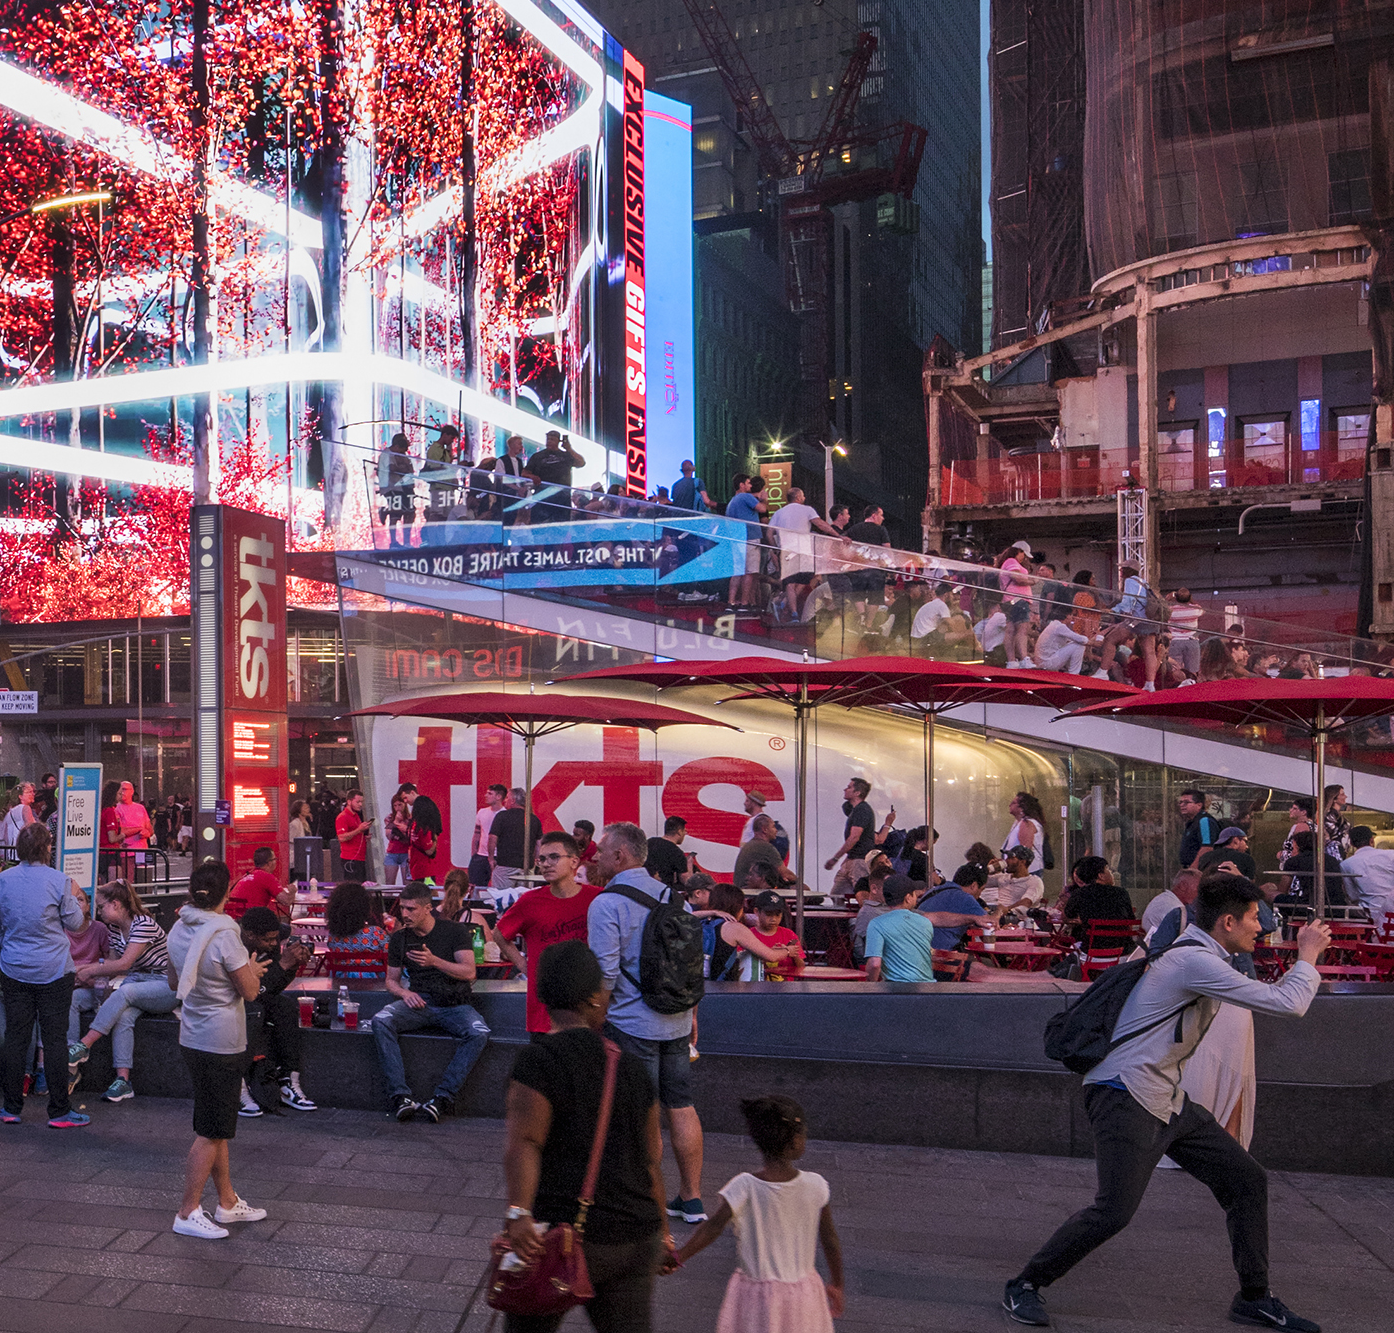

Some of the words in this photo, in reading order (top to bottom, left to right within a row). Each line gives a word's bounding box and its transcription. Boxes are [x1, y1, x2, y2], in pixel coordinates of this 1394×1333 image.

[625, 66, 645, 278] EXCLUSIVE
[626, 279, 646, 396] GIFTS
[765, 468, 787, 520] nigh
[240, 532, 276, 699] tkts
[1, 703, 14, 711] KEEP
[15, 703, 35, 711] MOVING
[6, 694, 20, 702] FLOW
[21, 694, 34, 702] ZONE
[67, 811, 84, 823] Live
[68, 795, 85, 808] Free
[398, 723, 790, 886] tkts
[67, 824, 92, 837] Music
